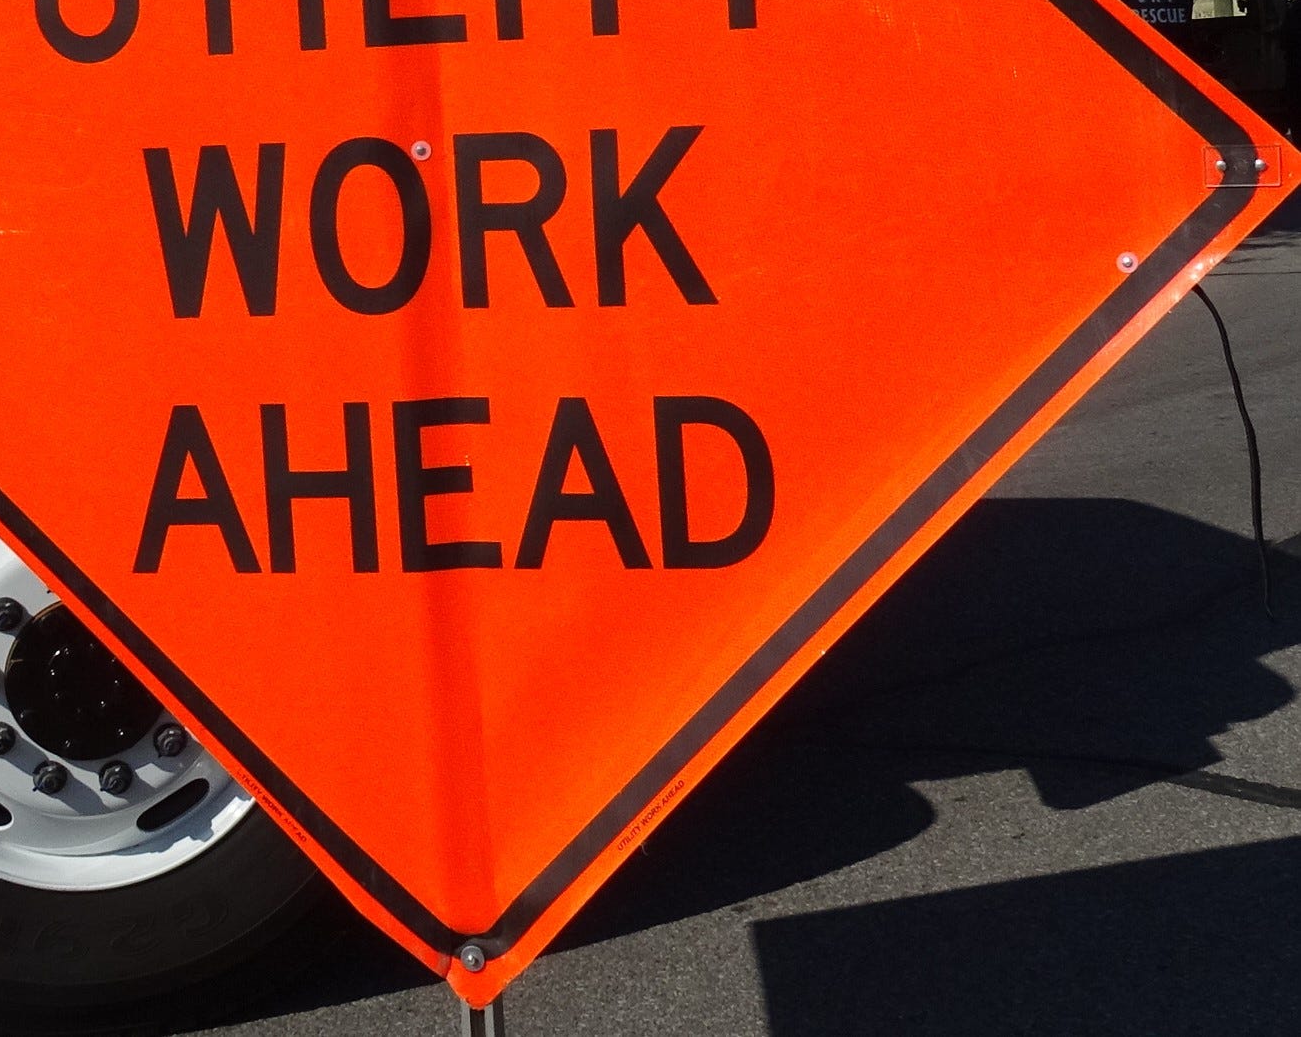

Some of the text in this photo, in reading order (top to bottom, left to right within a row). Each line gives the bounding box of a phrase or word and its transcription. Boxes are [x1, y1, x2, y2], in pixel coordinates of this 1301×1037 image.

[143, 125, 719, 320] WORK
[132, 396, 776, 574] AHEAD
[616, 778, 686, 851] UTILITY WORK AHEAD
